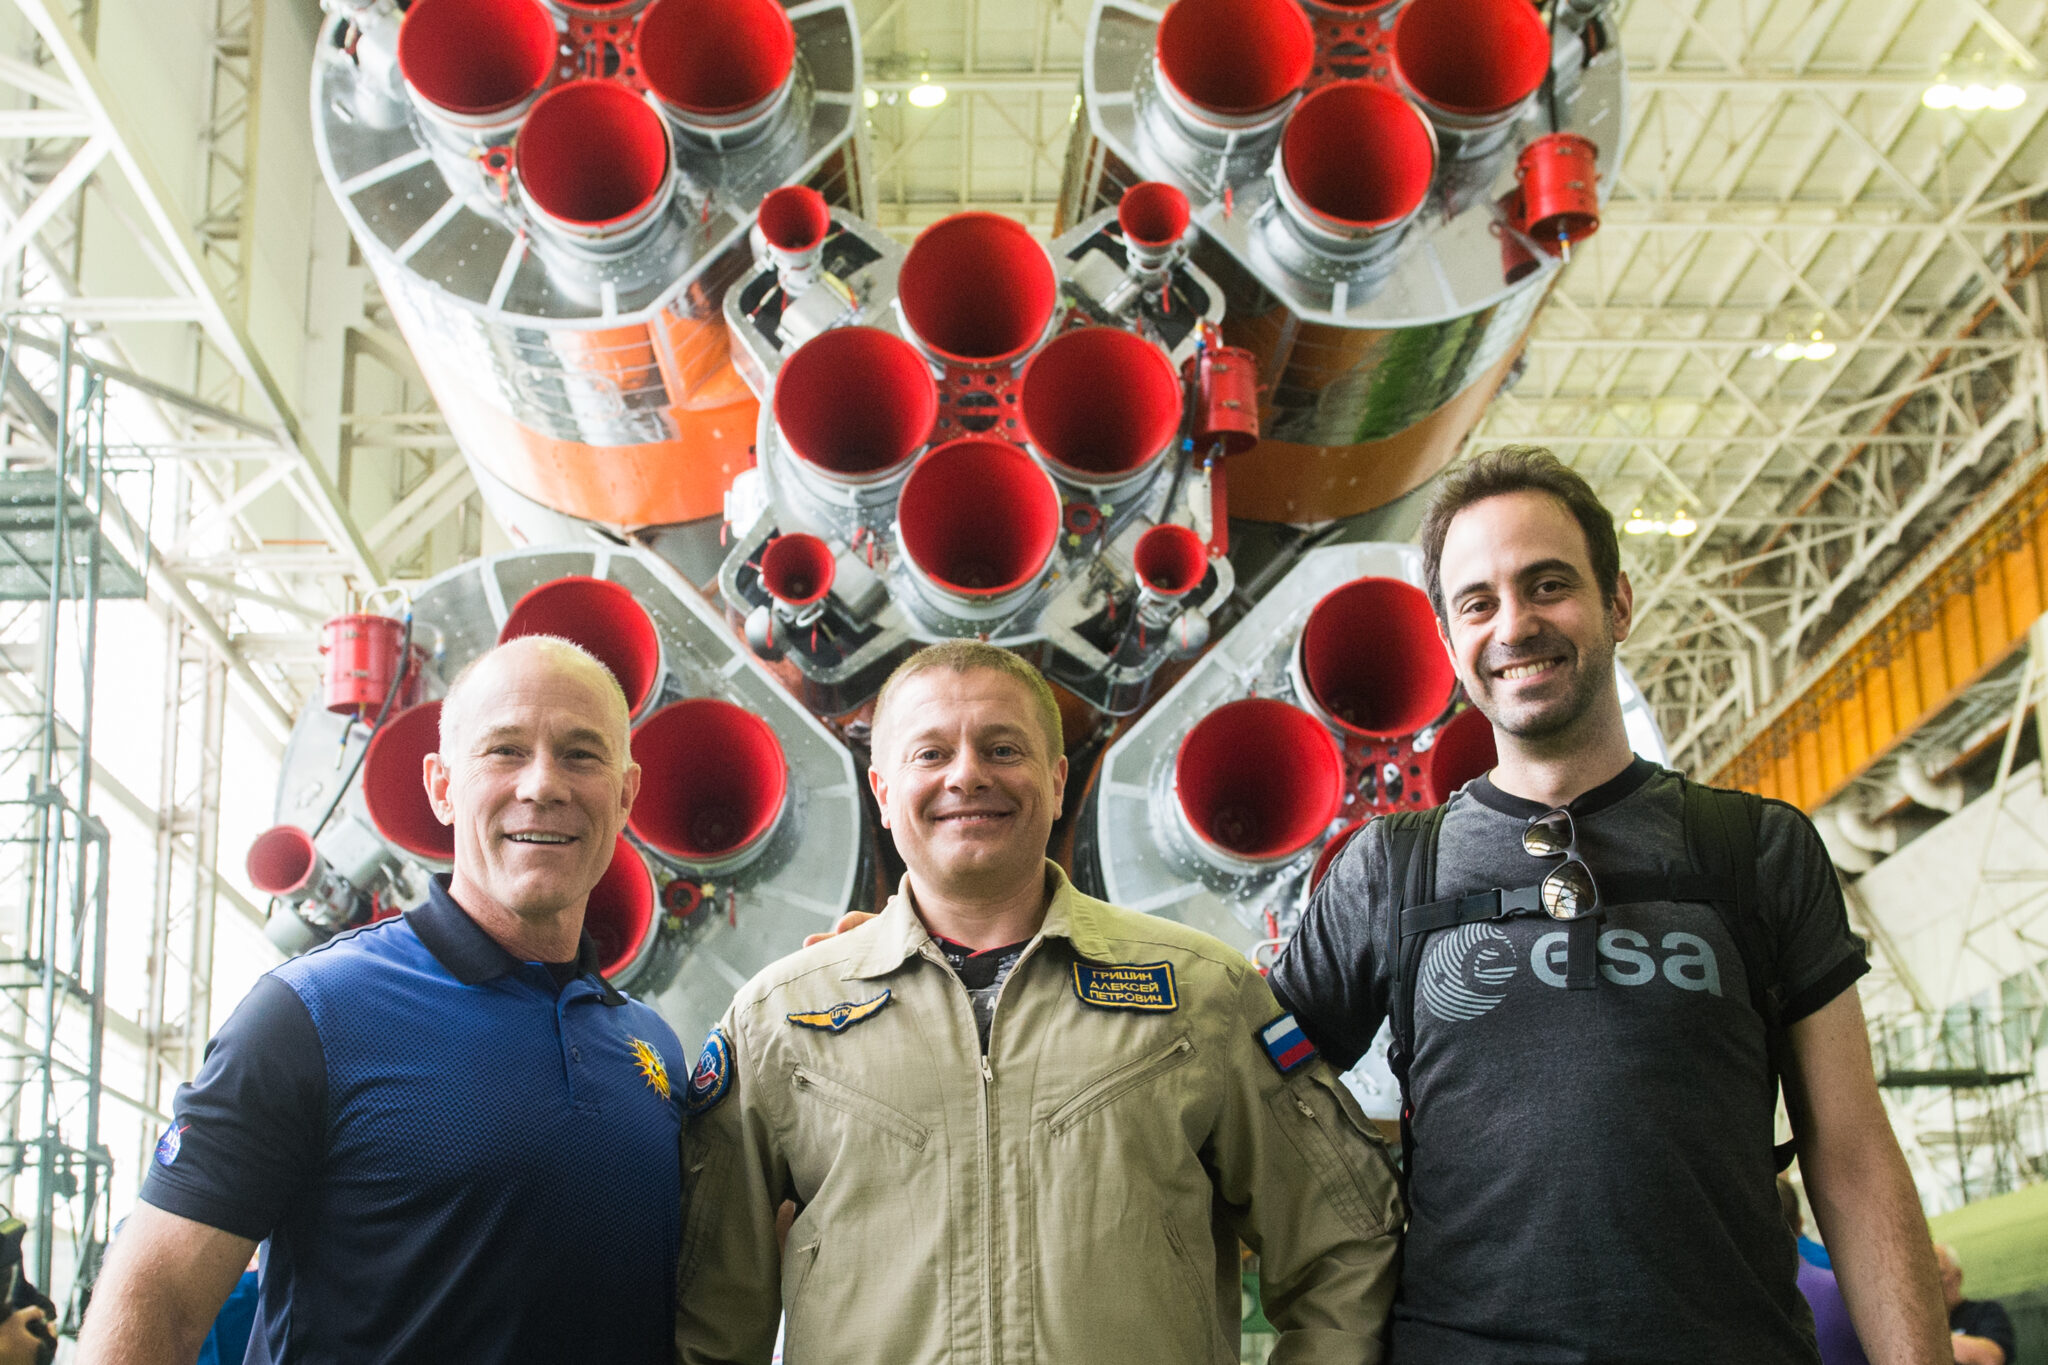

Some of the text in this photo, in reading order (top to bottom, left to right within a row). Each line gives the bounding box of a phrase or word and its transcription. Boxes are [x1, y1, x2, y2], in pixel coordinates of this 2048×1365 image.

[1092, 971, 1152, 981] ГРИШИН
[1089, 981, 1159, 992] АЛЕКСЕЙ
[1089, 990, 1163, 1003] ПЕТРОВИЧ
